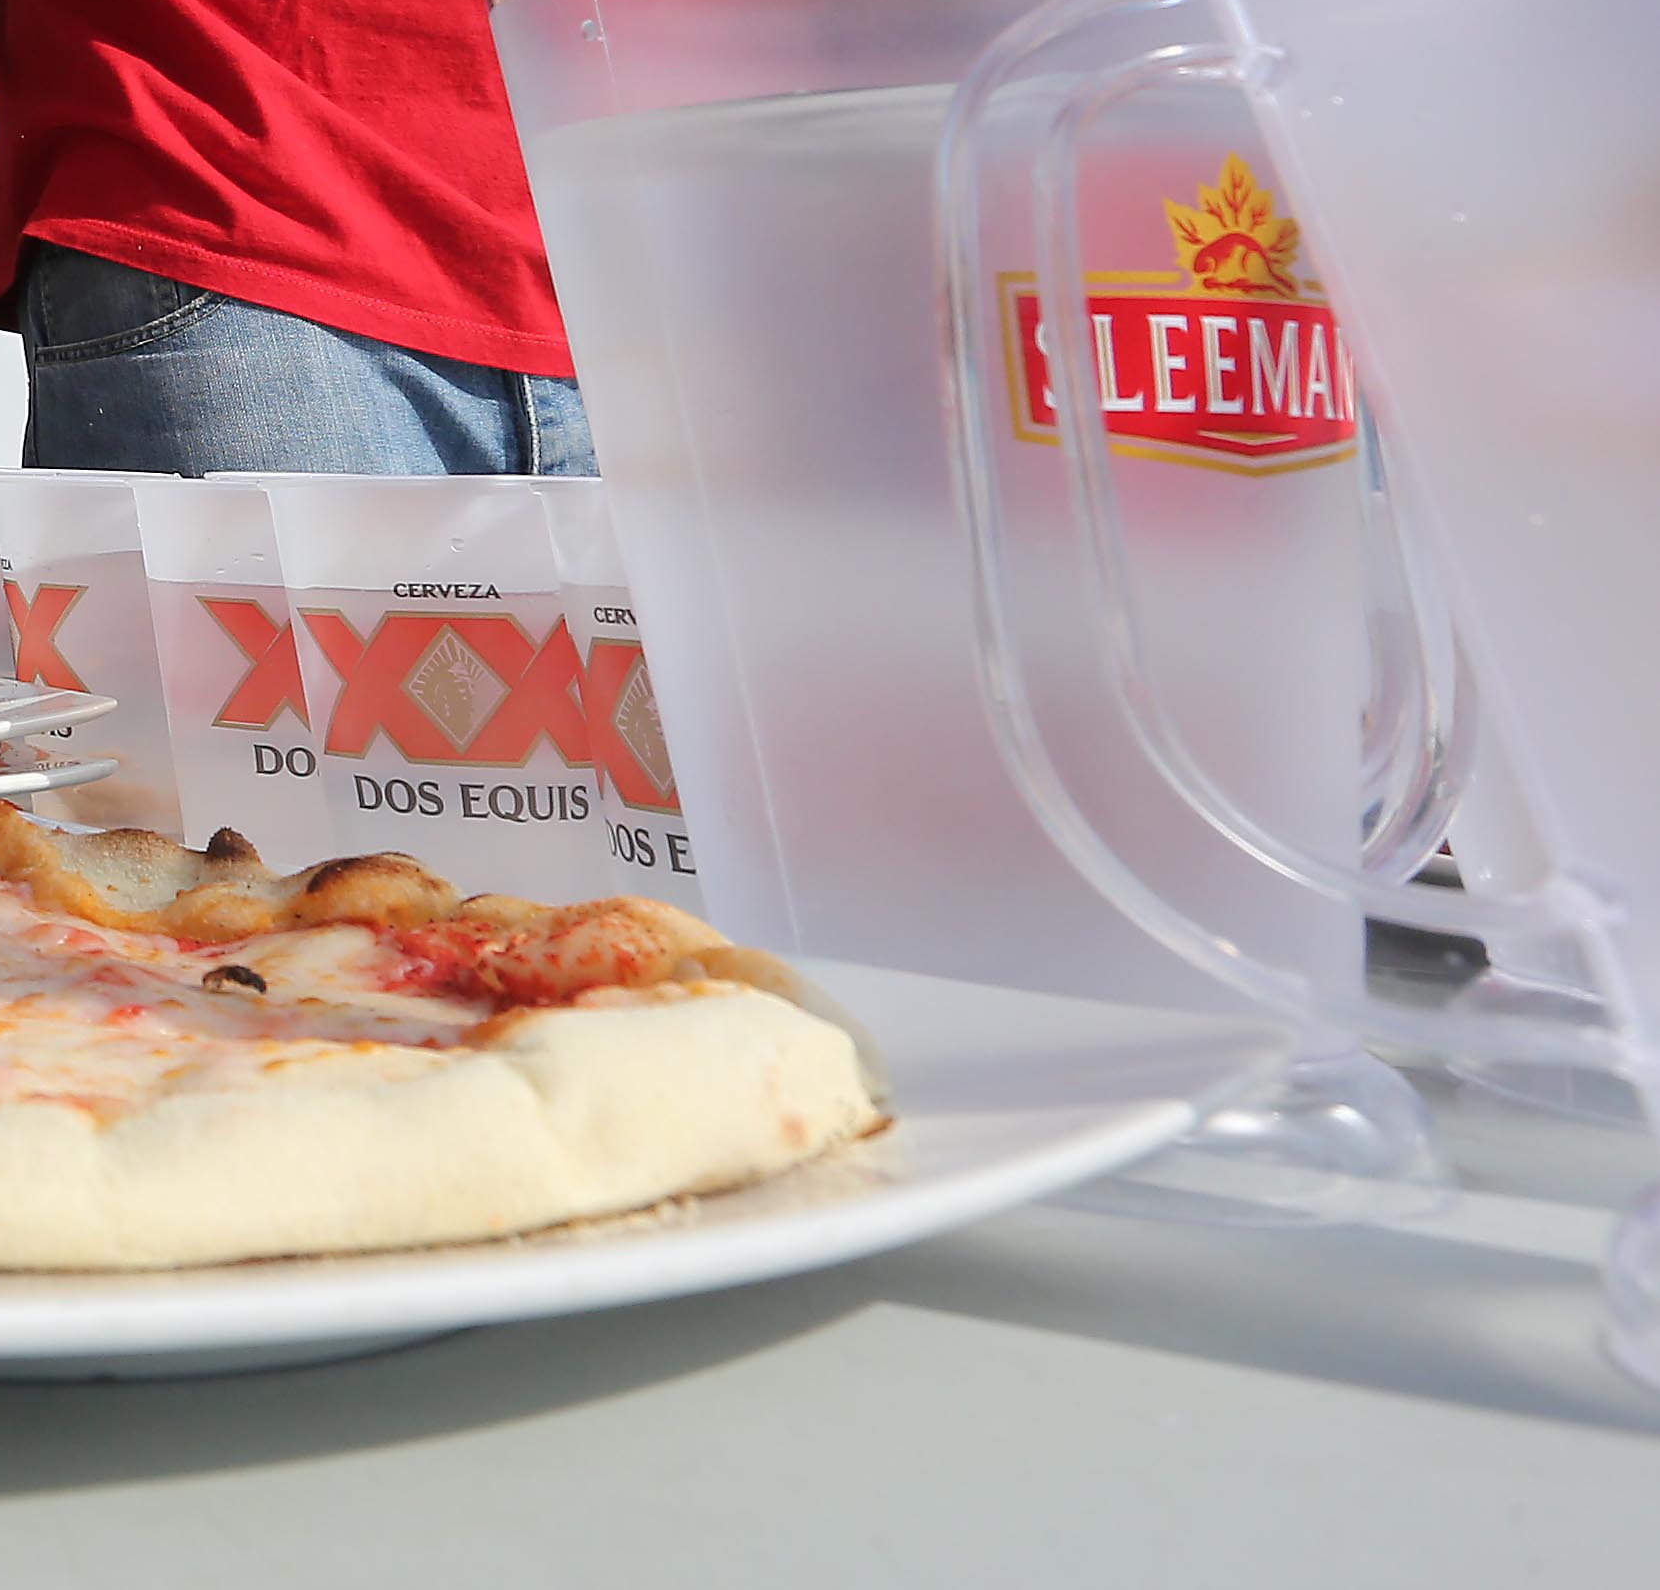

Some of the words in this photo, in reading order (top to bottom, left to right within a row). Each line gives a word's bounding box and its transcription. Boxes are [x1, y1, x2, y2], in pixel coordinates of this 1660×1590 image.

[393, 583, 502, 599] CERVEZA
[253, 744, 317, 778] DO
[353, 774, 445, 816] DOS
[459, 782, 590, 823] EQUIS
